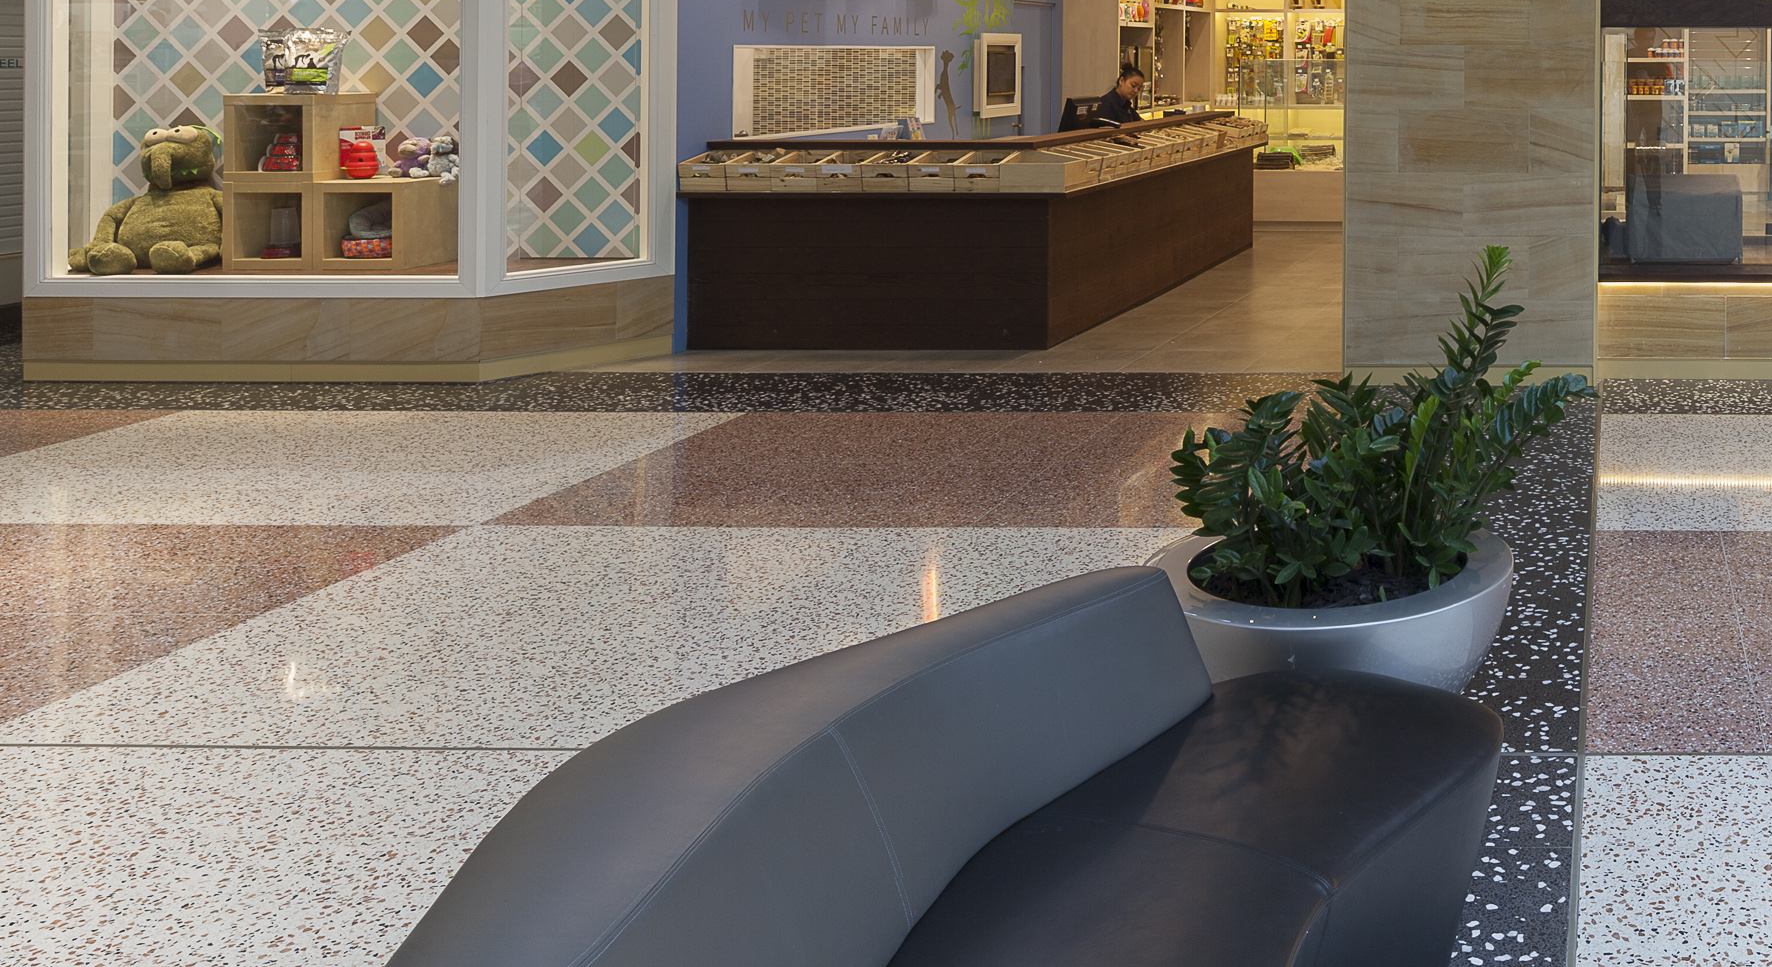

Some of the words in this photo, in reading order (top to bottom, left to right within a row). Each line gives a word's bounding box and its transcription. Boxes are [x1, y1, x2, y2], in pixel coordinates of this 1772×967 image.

[742, 9, 771, 33] MY
[785, 11, 823, 34] PET
[836, 14, 860, 35] MY
[871, 15, 929, 37] FAMILY
